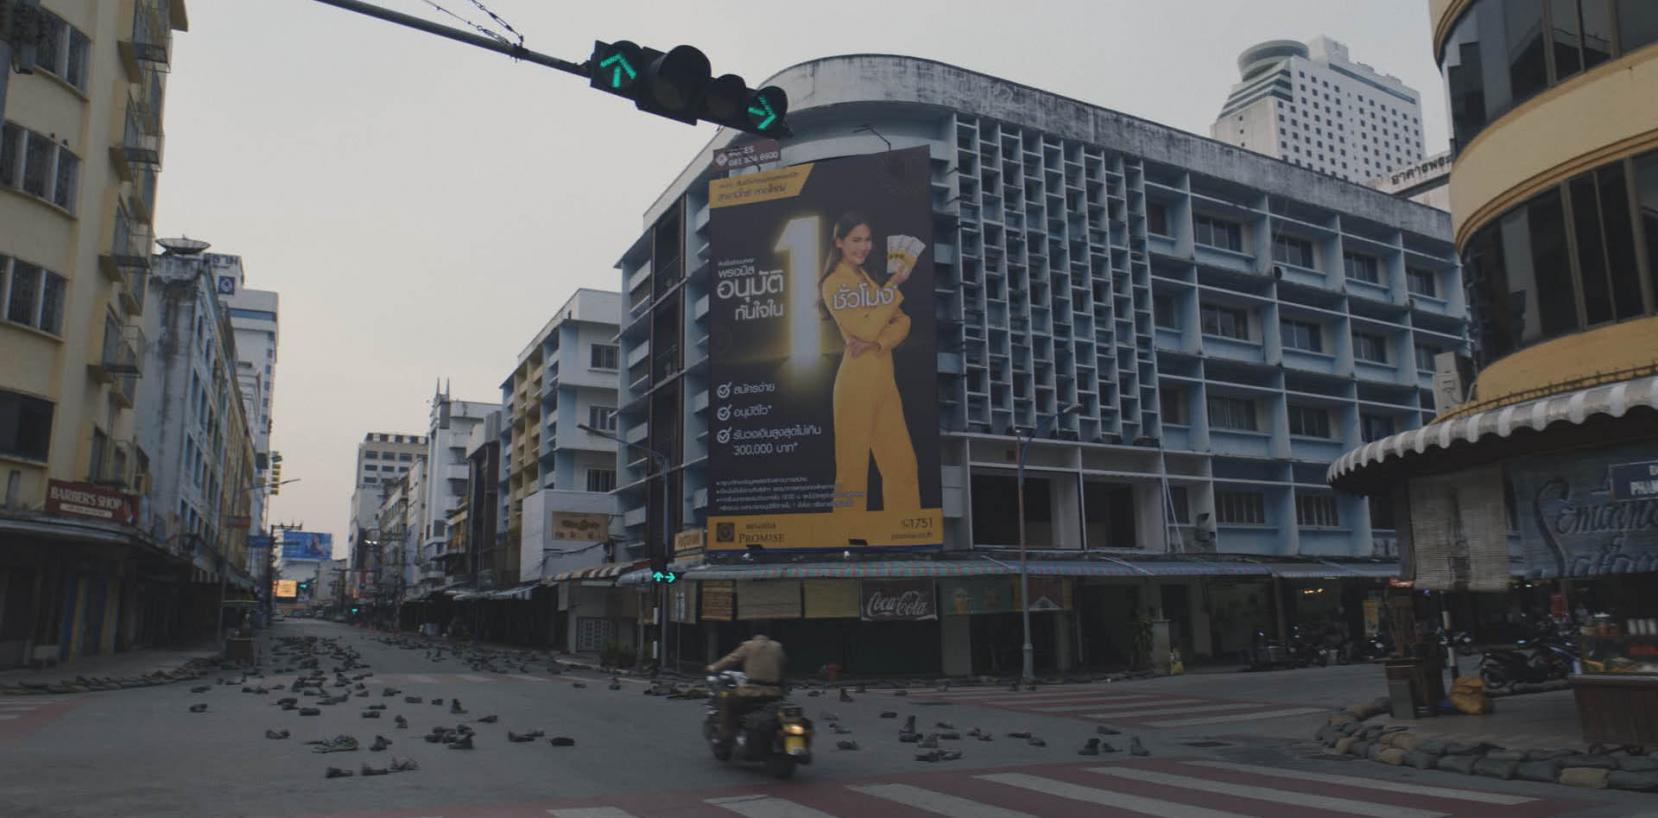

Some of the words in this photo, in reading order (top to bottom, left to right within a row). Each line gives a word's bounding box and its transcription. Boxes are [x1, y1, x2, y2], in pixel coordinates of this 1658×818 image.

[717, 270, 784, 303] อนุมัติ
[773, 215, 820, 366] 1
[735, 299, 784, 321] ทันใจใน
[733, 443, 773, 456] 300,000
